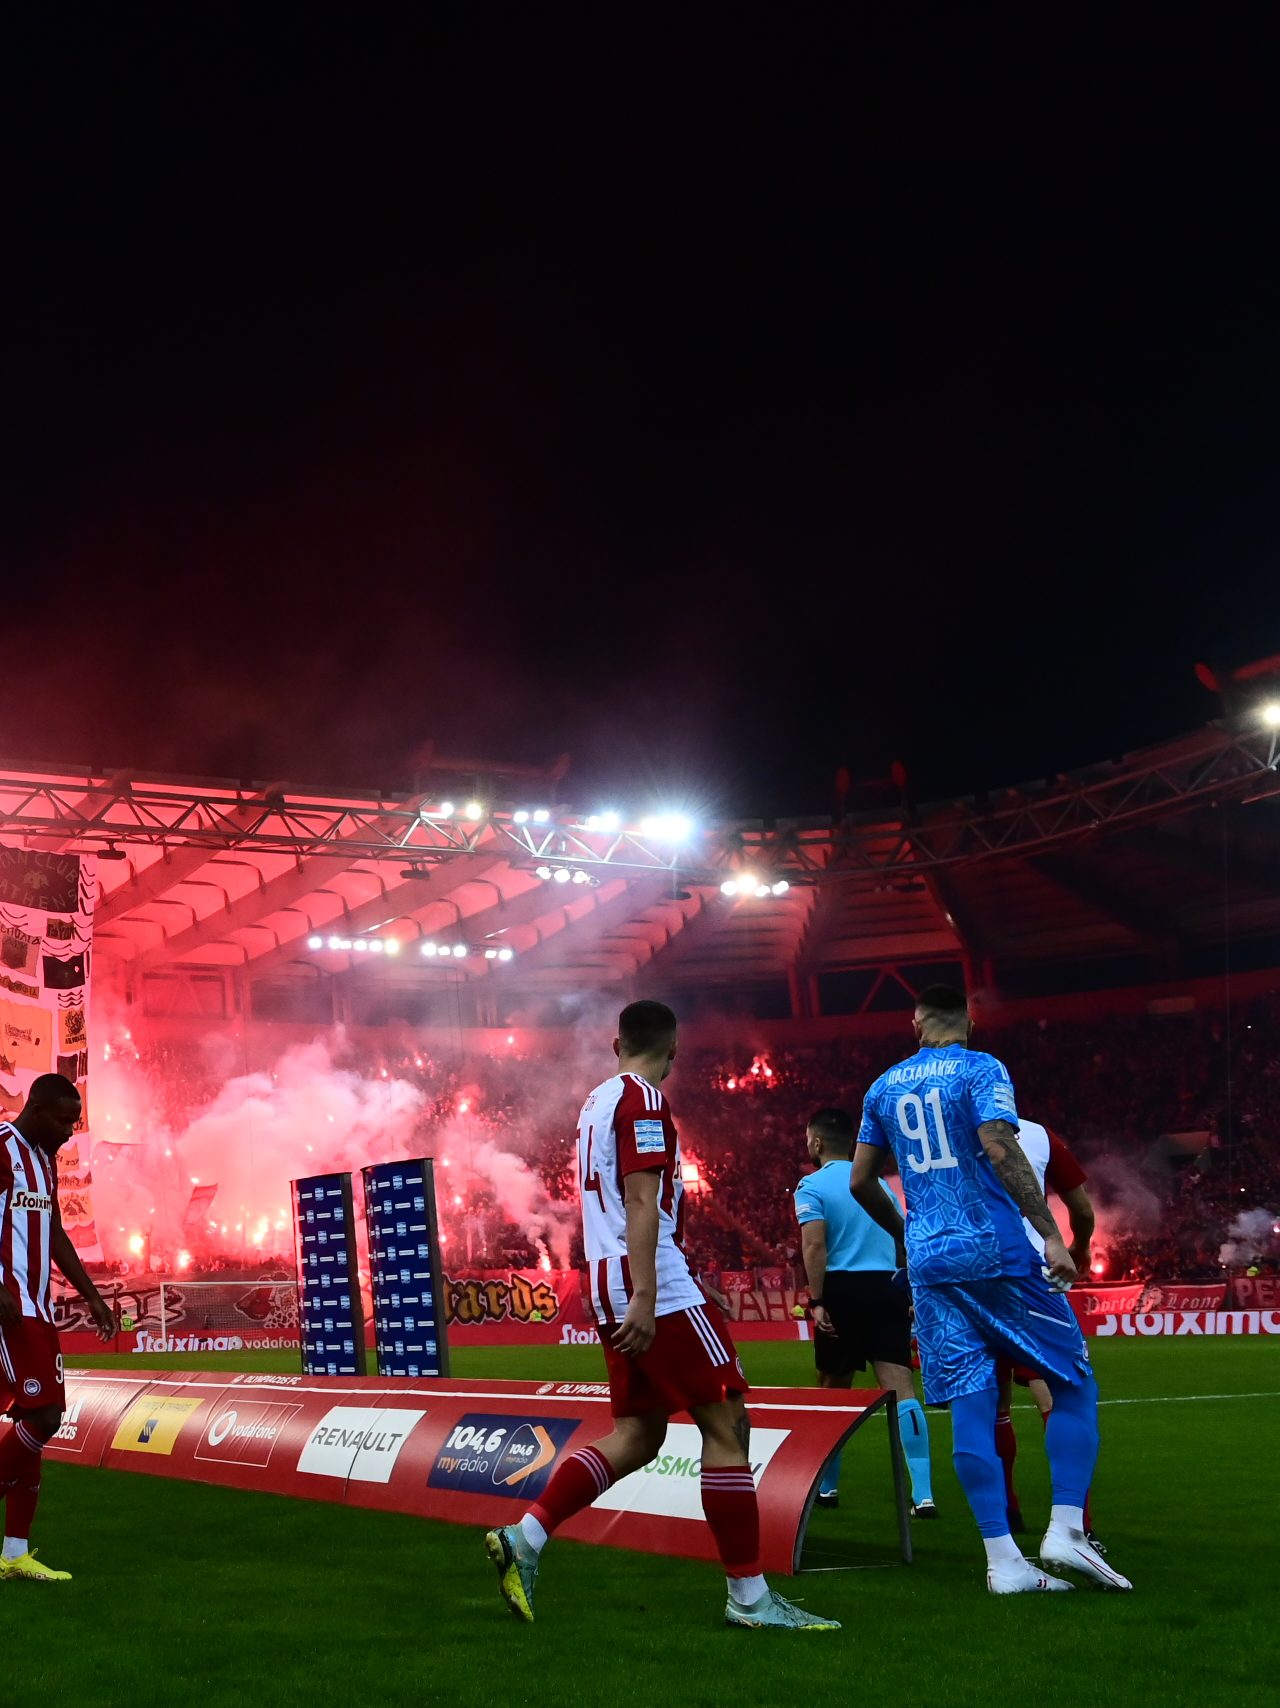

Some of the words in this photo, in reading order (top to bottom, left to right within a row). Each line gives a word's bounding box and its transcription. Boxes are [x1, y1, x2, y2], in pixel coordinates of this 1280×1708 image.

[896, 1088, 958, 1173] 91
[1234, 1278, 1280, 1307] PE
[245, 1337, 300, 1349] vodafon
[556, 1383, 611, 1395] OLYMPIA
[231, 1421, 276, 1440] vodafone
[311, 1427, 403, 1453] RENAULT
[446, 1426, 507, 1454] 104,6
[509, 1443, 535, 1457] 104,6
[437, 1455, 489, 1474] myradio
